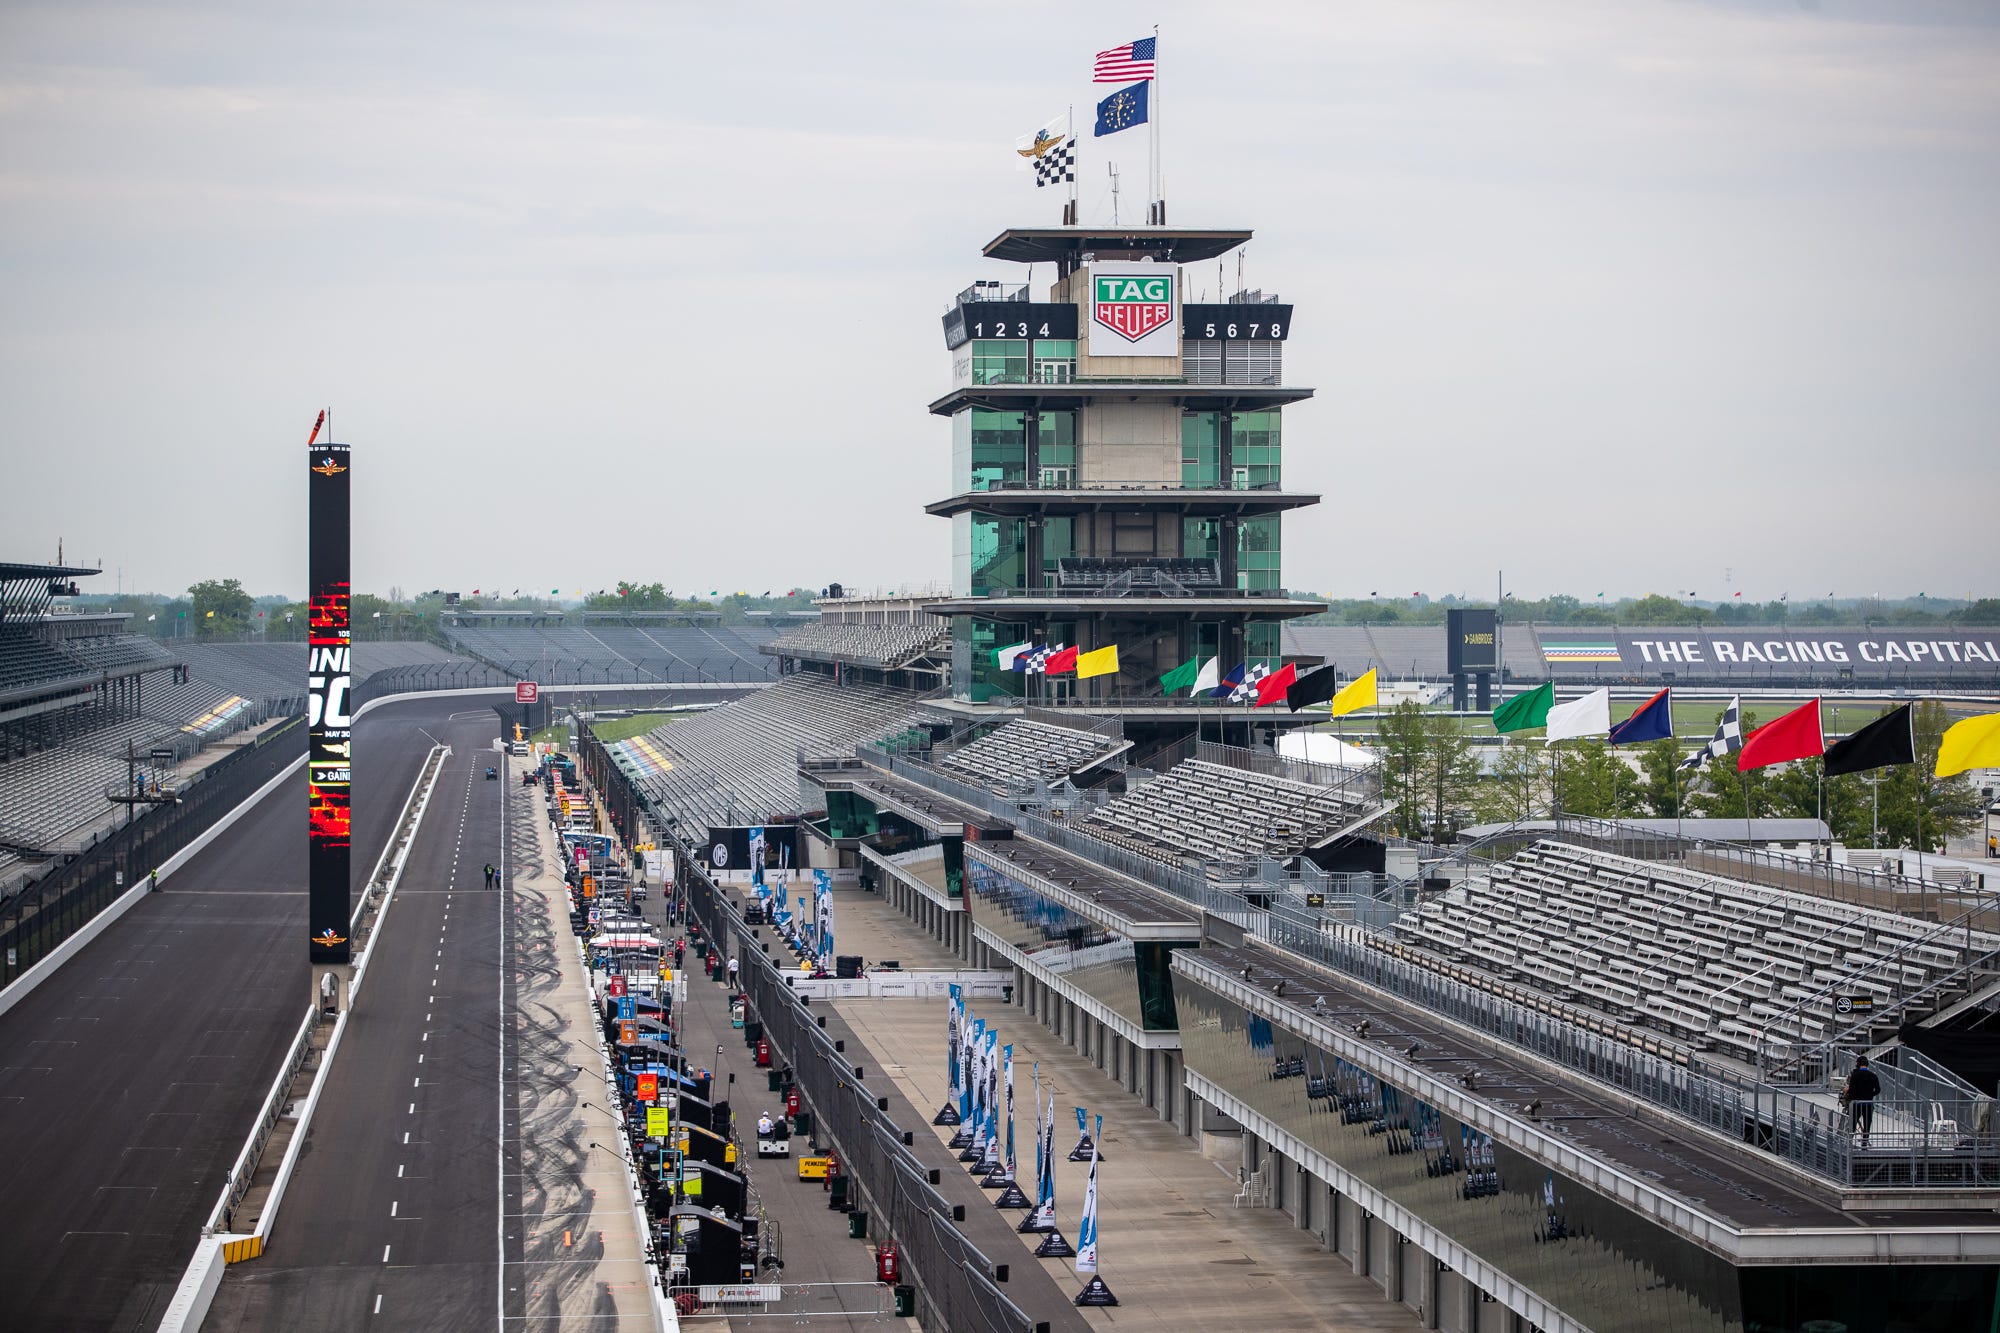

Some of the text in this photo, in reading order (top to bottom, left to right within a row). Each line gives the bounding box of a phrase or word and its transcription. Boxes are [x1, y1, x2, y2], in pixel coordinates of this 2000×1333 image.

[1101, 280, 1164, 300] TAG
[1099, 305, 1167, 336] HEUER
[974, 322, 982, 337] 1
[995, 322, 1006, 337] 2
[1017, 322, 1028, 337] 3
[1039, 322, 1050, 337] 4
[1205, 323, 1281, 338] 5 6 7 8
[1469, 633, 1493, 645] GAINBRIDGE
[1631, 641, 1705, 663] THE
[1711, 641, 1850, 663] RACING
